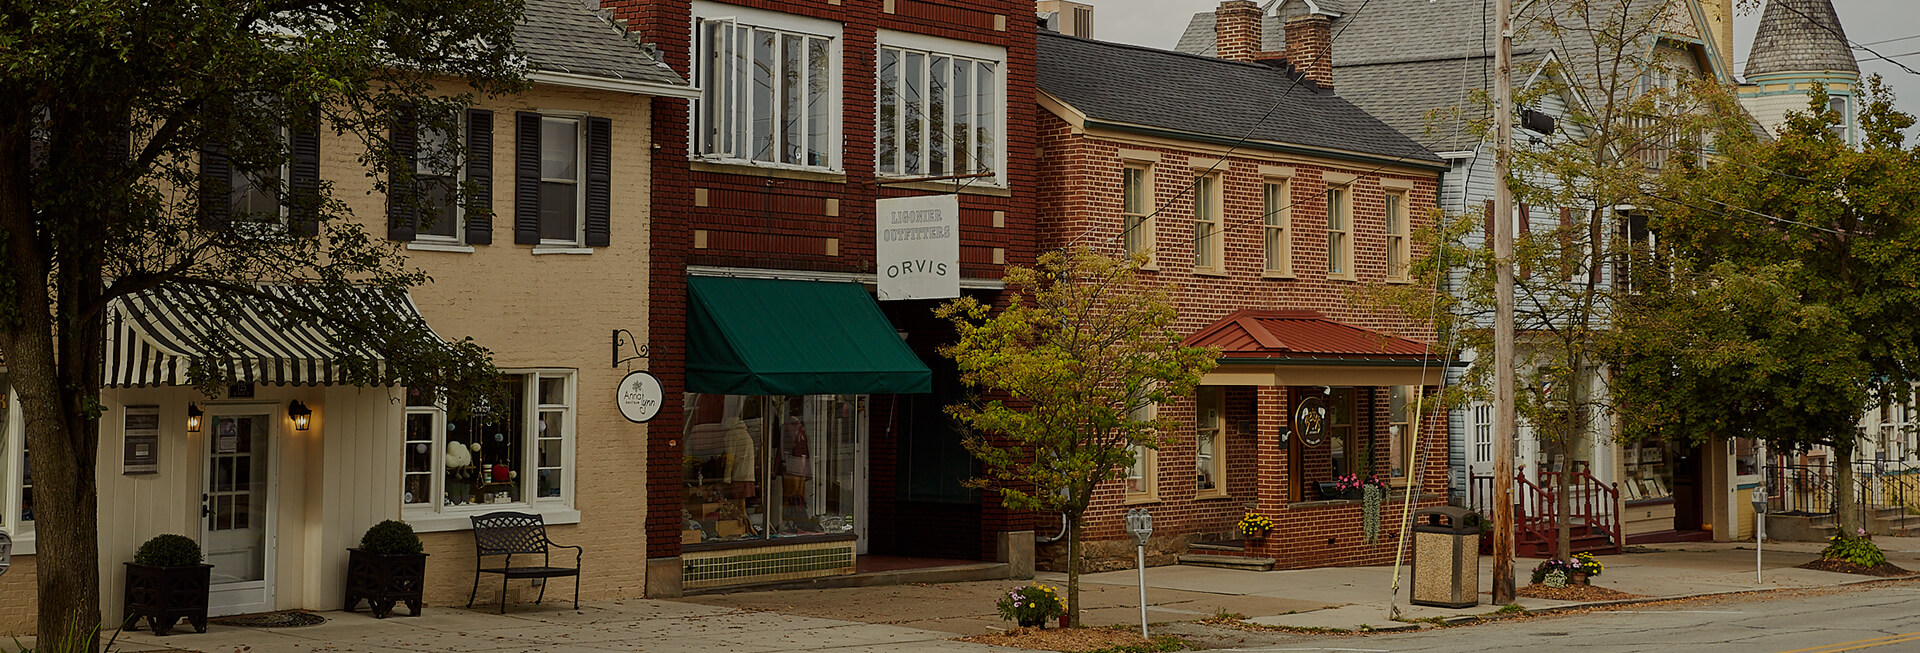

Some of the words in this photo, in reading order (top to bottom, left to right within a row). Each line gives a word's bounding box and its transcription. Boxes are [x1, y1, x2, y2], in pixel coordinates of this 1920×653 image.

[891, 209, 943, 224] LIGONIER
[883, 226, 951, 242] OUTFITTERS
[887, 259, 947, 278] ORVIS
